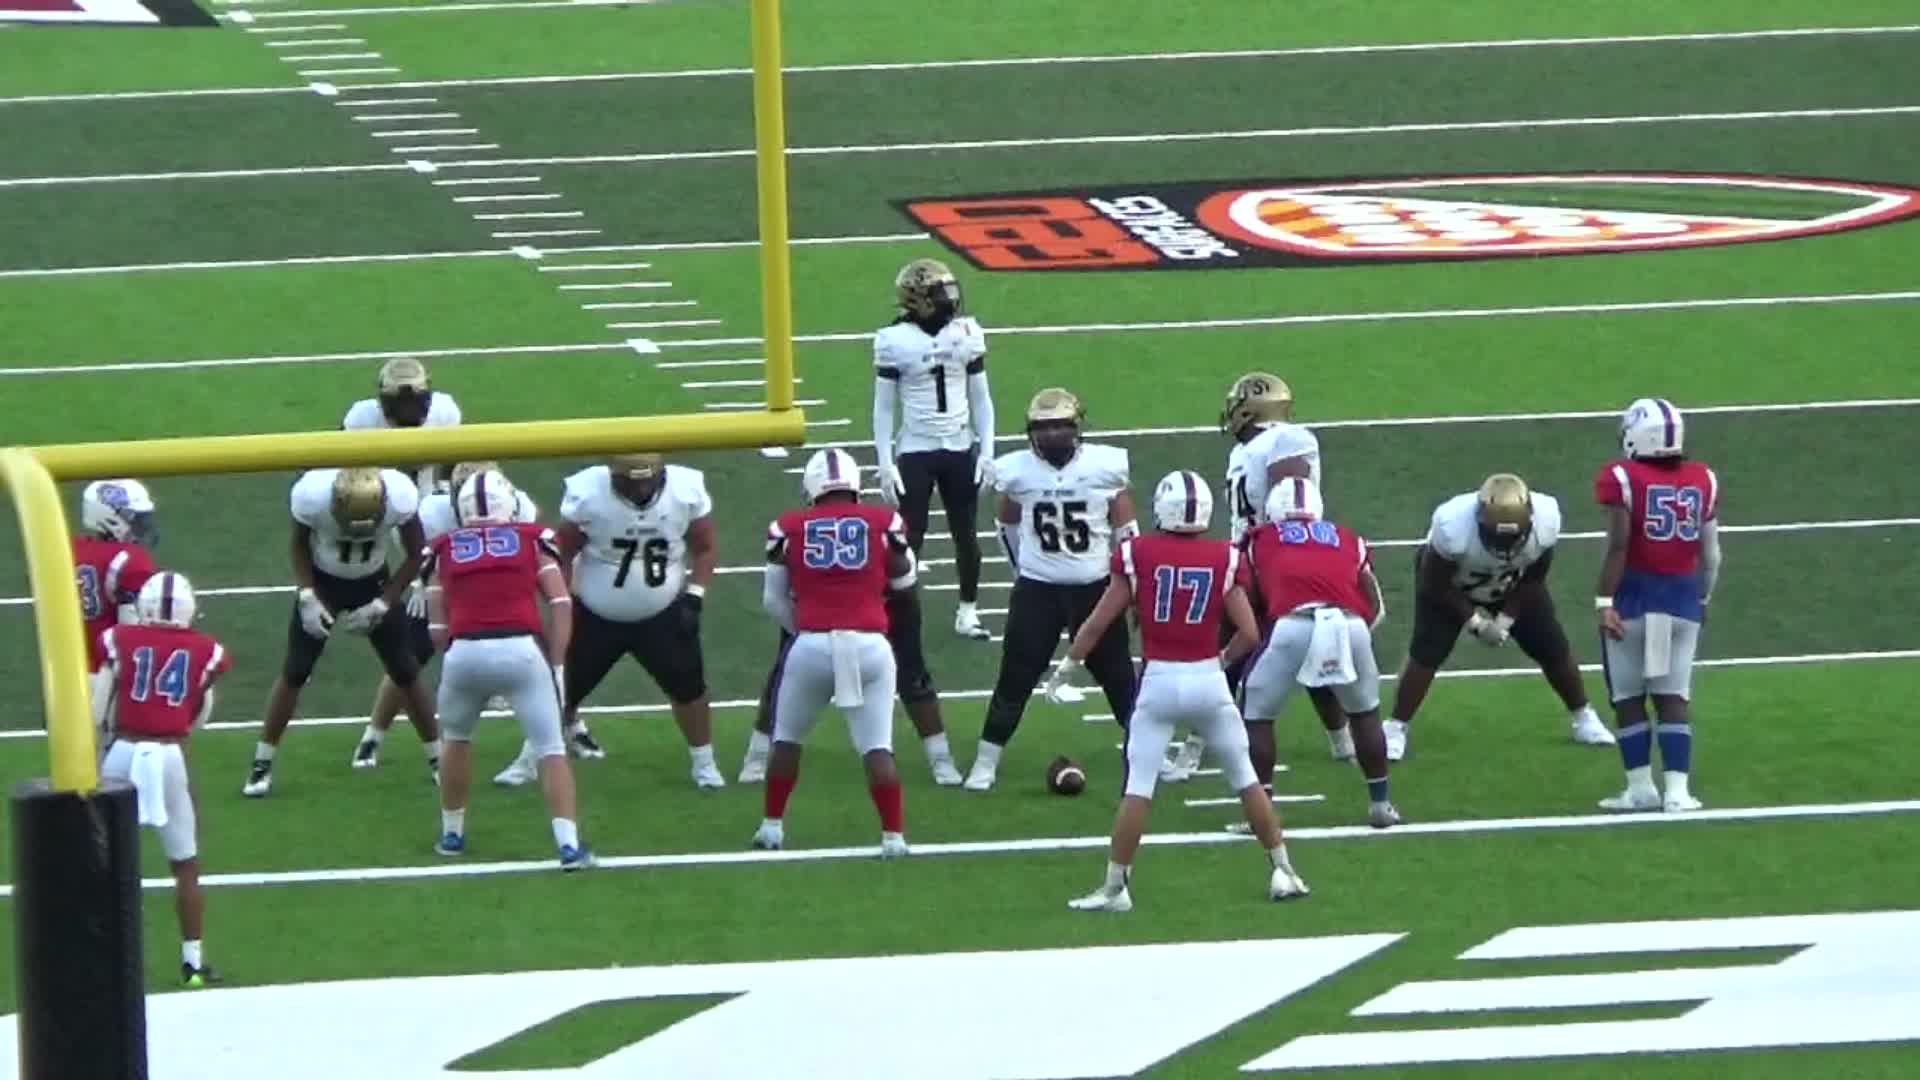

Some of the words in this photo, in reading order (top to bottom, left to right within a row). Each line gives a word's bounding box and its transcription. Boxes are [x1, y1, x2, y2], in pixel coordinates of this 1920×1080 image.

[930, 364, 948, 413] 1
[1033, 501, 1090, 553] 65
[1644, 484, 1703, 541] 53
[612, 538, 669, 589] 76
[803, 517, 869, 570] 59
[1154, 565, 1214, 624] 17
[130, 646, 191, 707] 14
